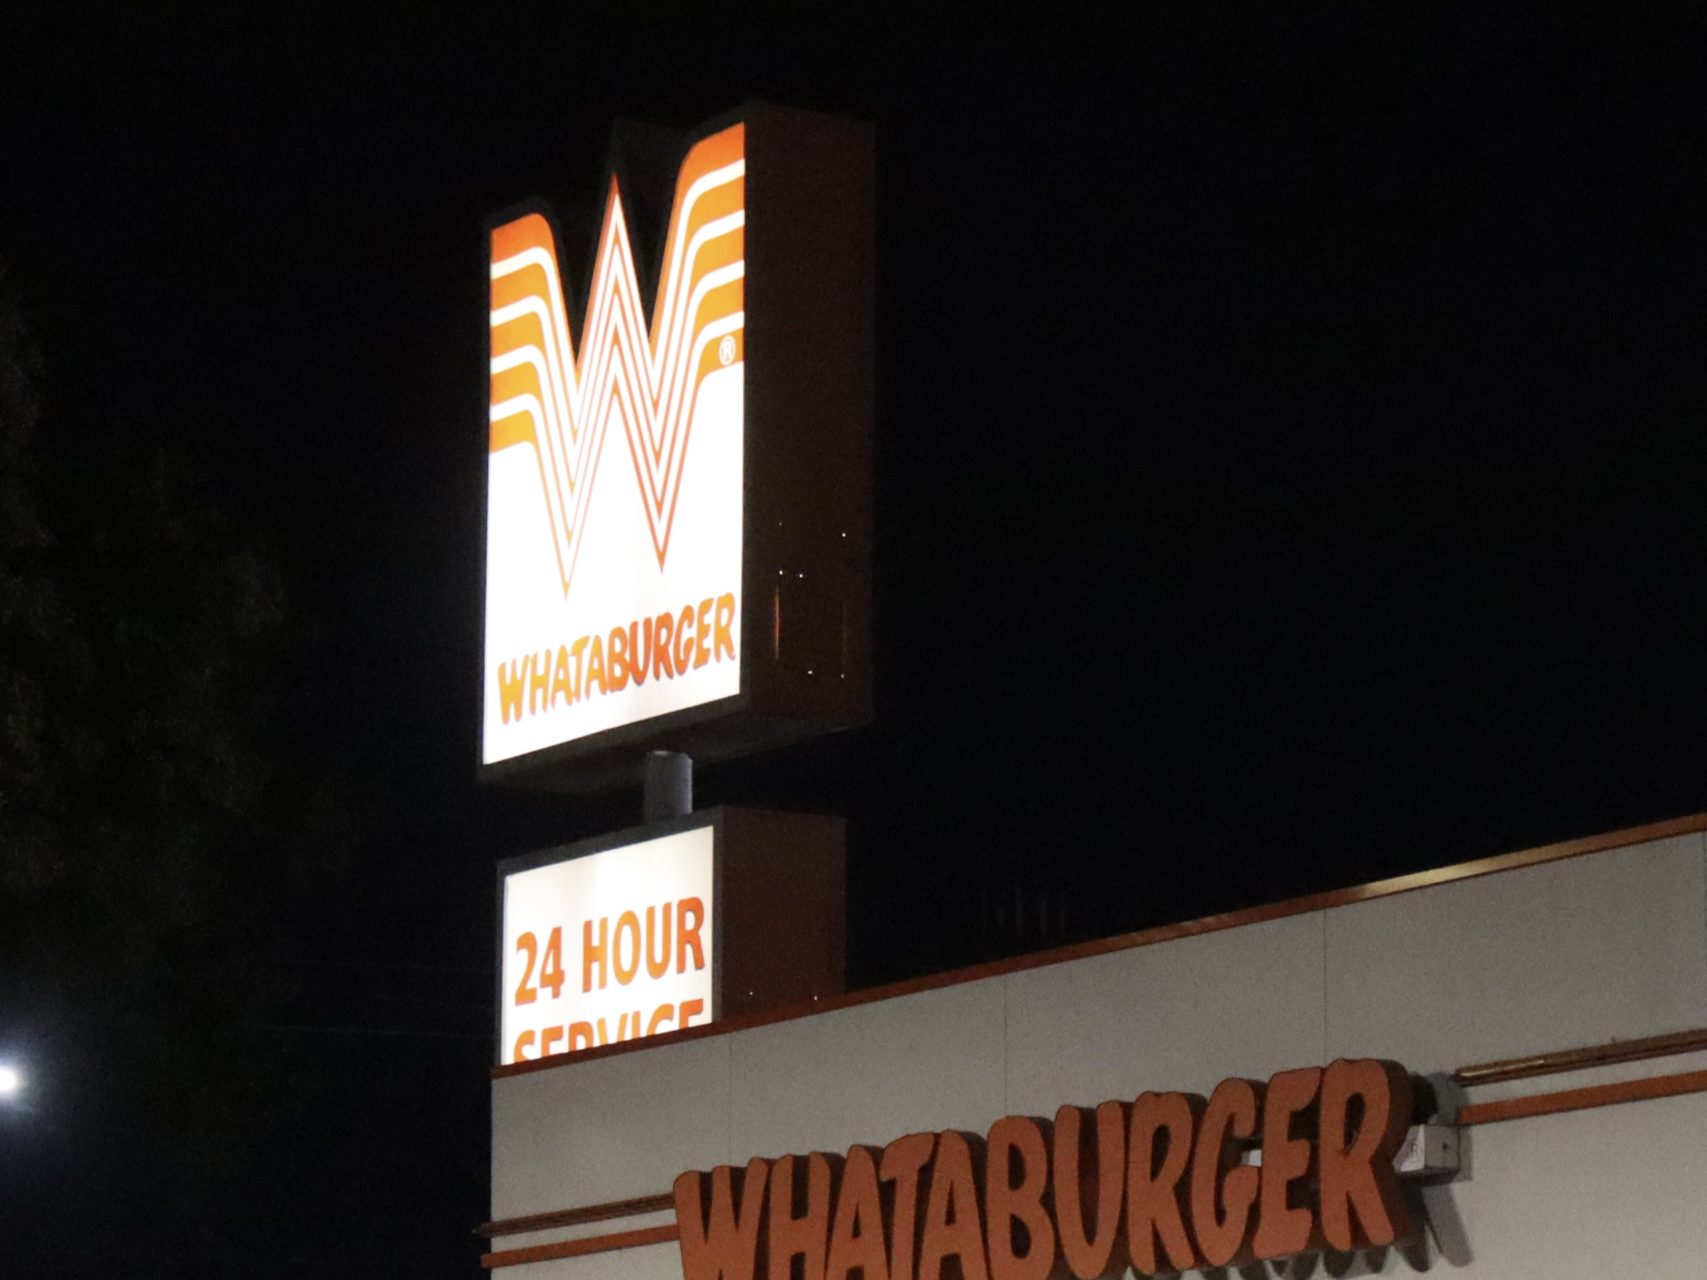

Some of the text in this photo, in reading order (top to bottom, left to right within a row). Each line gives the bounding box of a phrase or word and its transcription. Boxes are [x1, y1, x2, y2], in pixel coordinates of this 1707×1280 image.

[497, 592, 736, 726] WHATABURGER
[515, 897, 705, 1006] 24 HOUR
